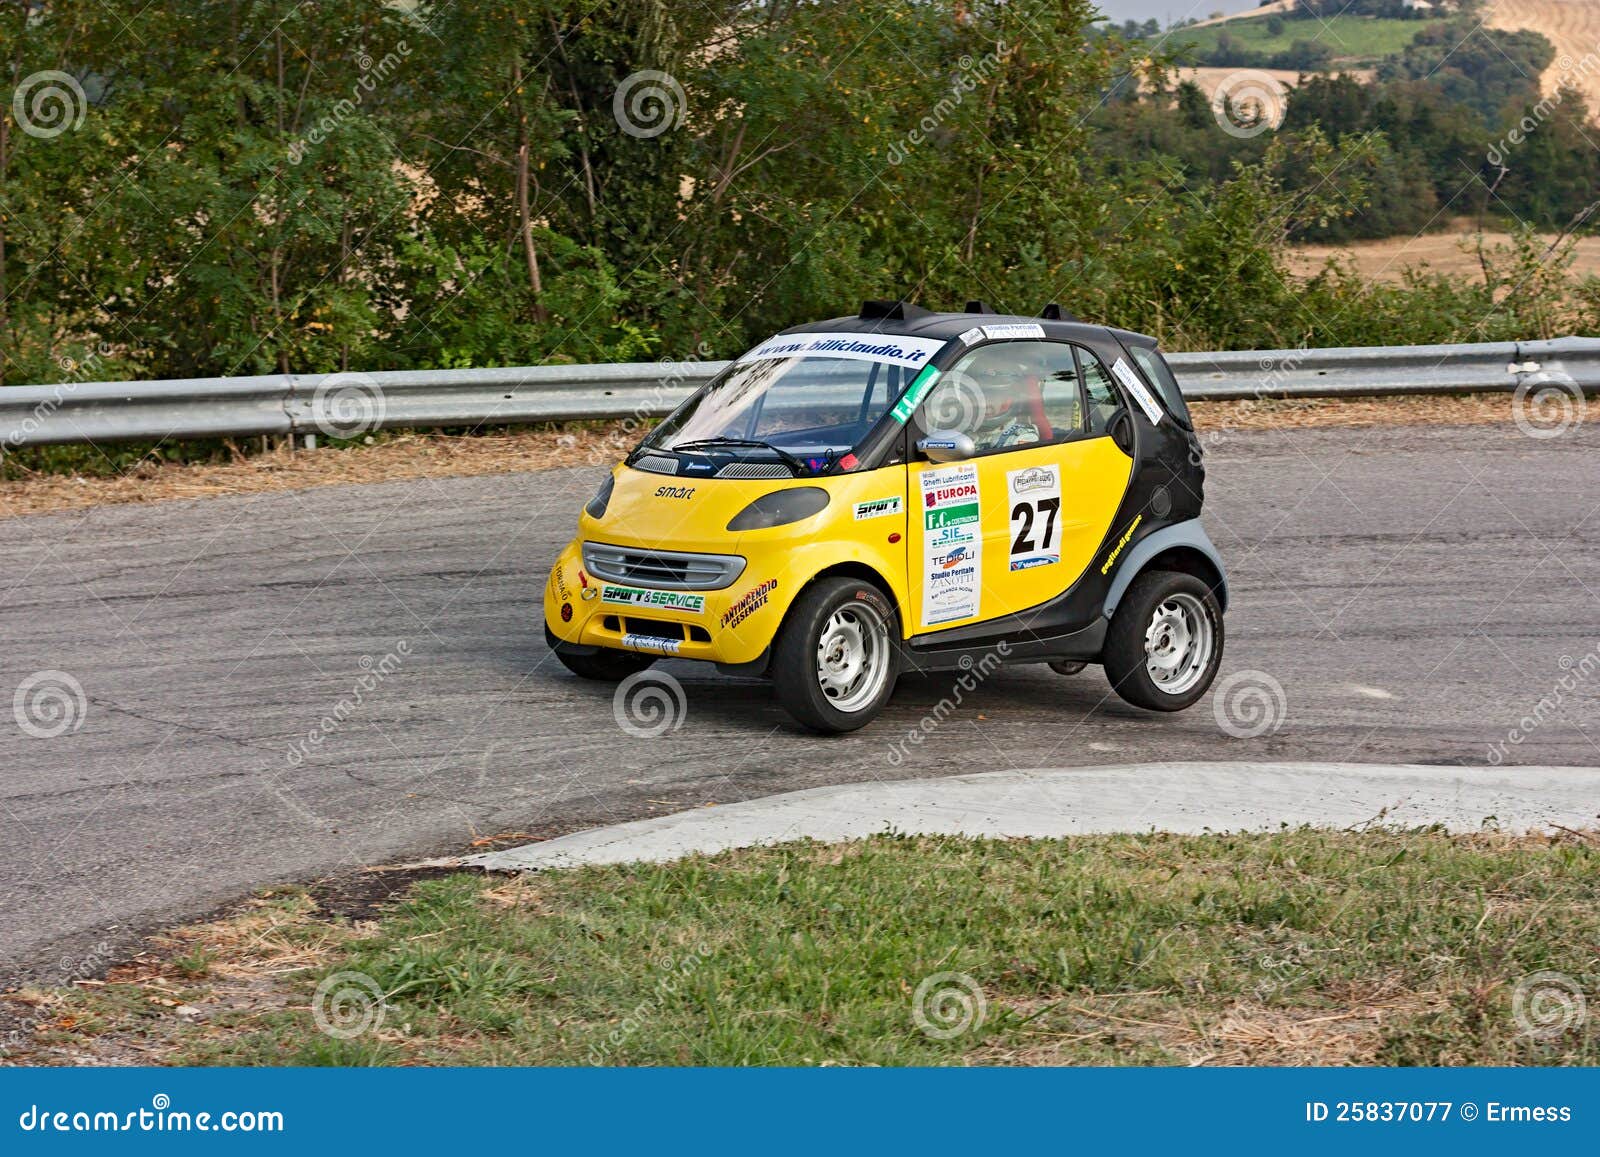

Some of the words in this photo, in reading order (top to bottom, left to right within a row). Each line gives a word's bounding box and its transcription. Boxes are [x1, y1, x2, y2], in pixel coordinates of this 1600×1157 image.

[655, 486, 695, 500] smart
[936, 484, 977, 501] EUROPA
[942, 527, 962, 540] SIE
[1010, 497, 1061, 555] 27
[931, 550, 975, 566] TEDIOLI
[931, 571, 951, 581] Studio
[731, 594, 768, 629] CESENATE
